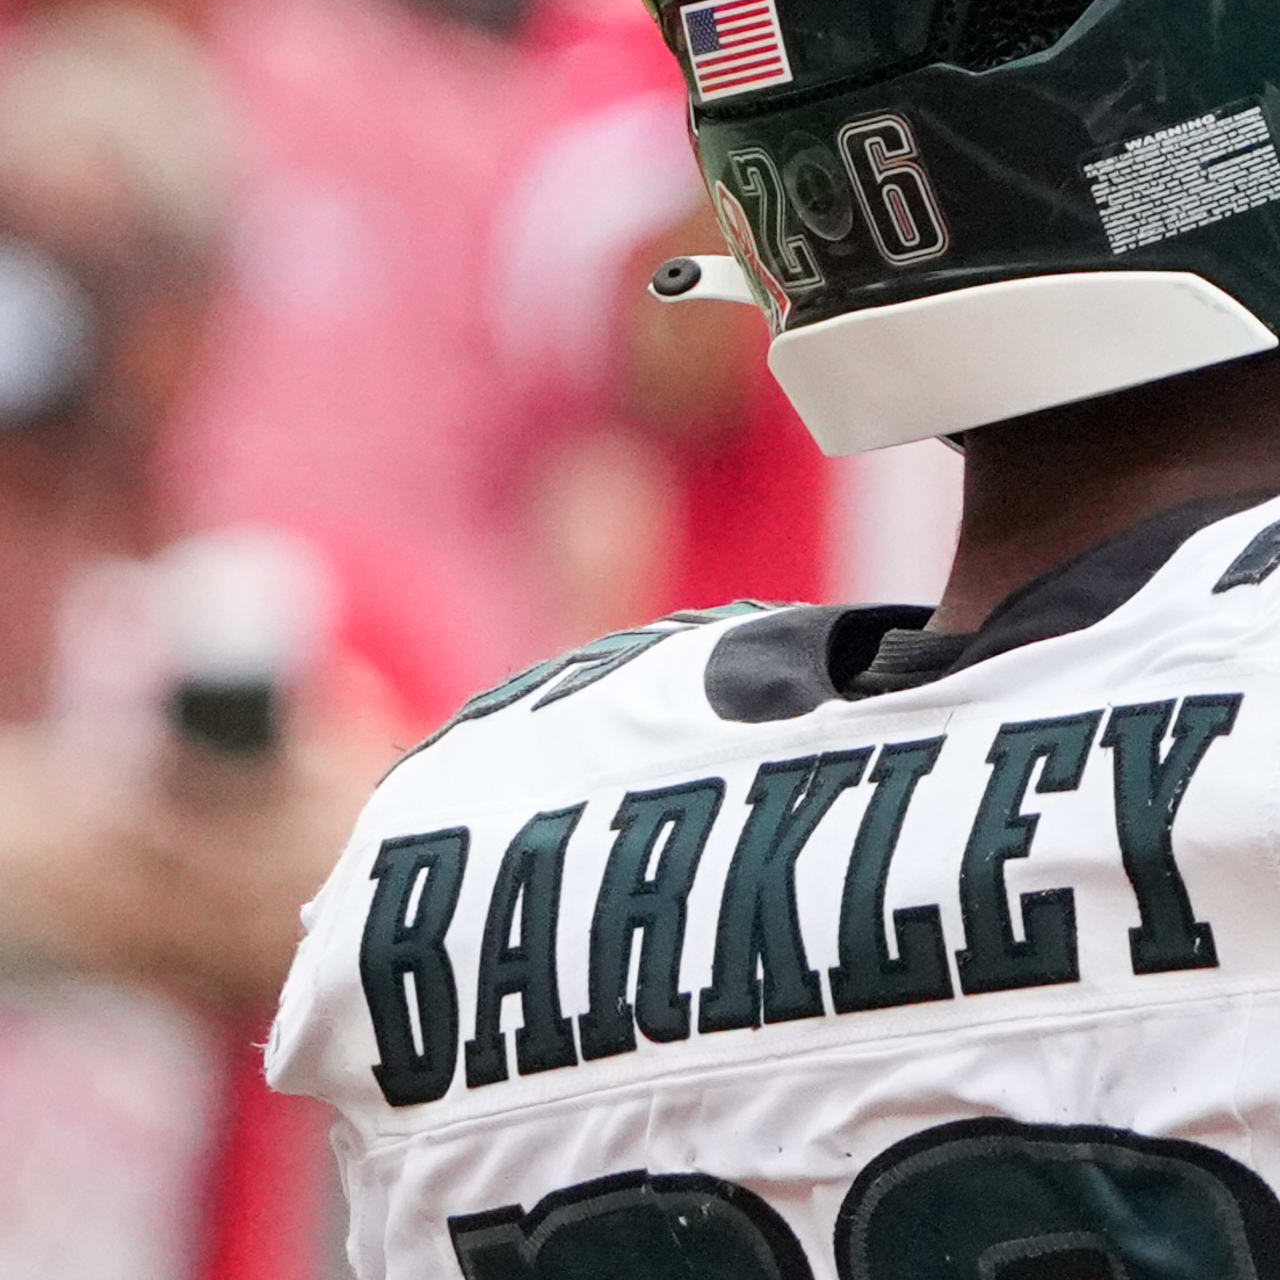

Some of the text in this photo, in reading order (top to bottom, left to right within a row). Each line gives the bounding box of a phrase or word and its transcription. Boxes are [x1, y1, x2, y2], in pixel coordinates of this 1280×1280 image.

[728, 114, 949, 291] 26
[1124, 113, 1216, 151] WARNING
[358, 692, 1245, 1107] BARKLEY
